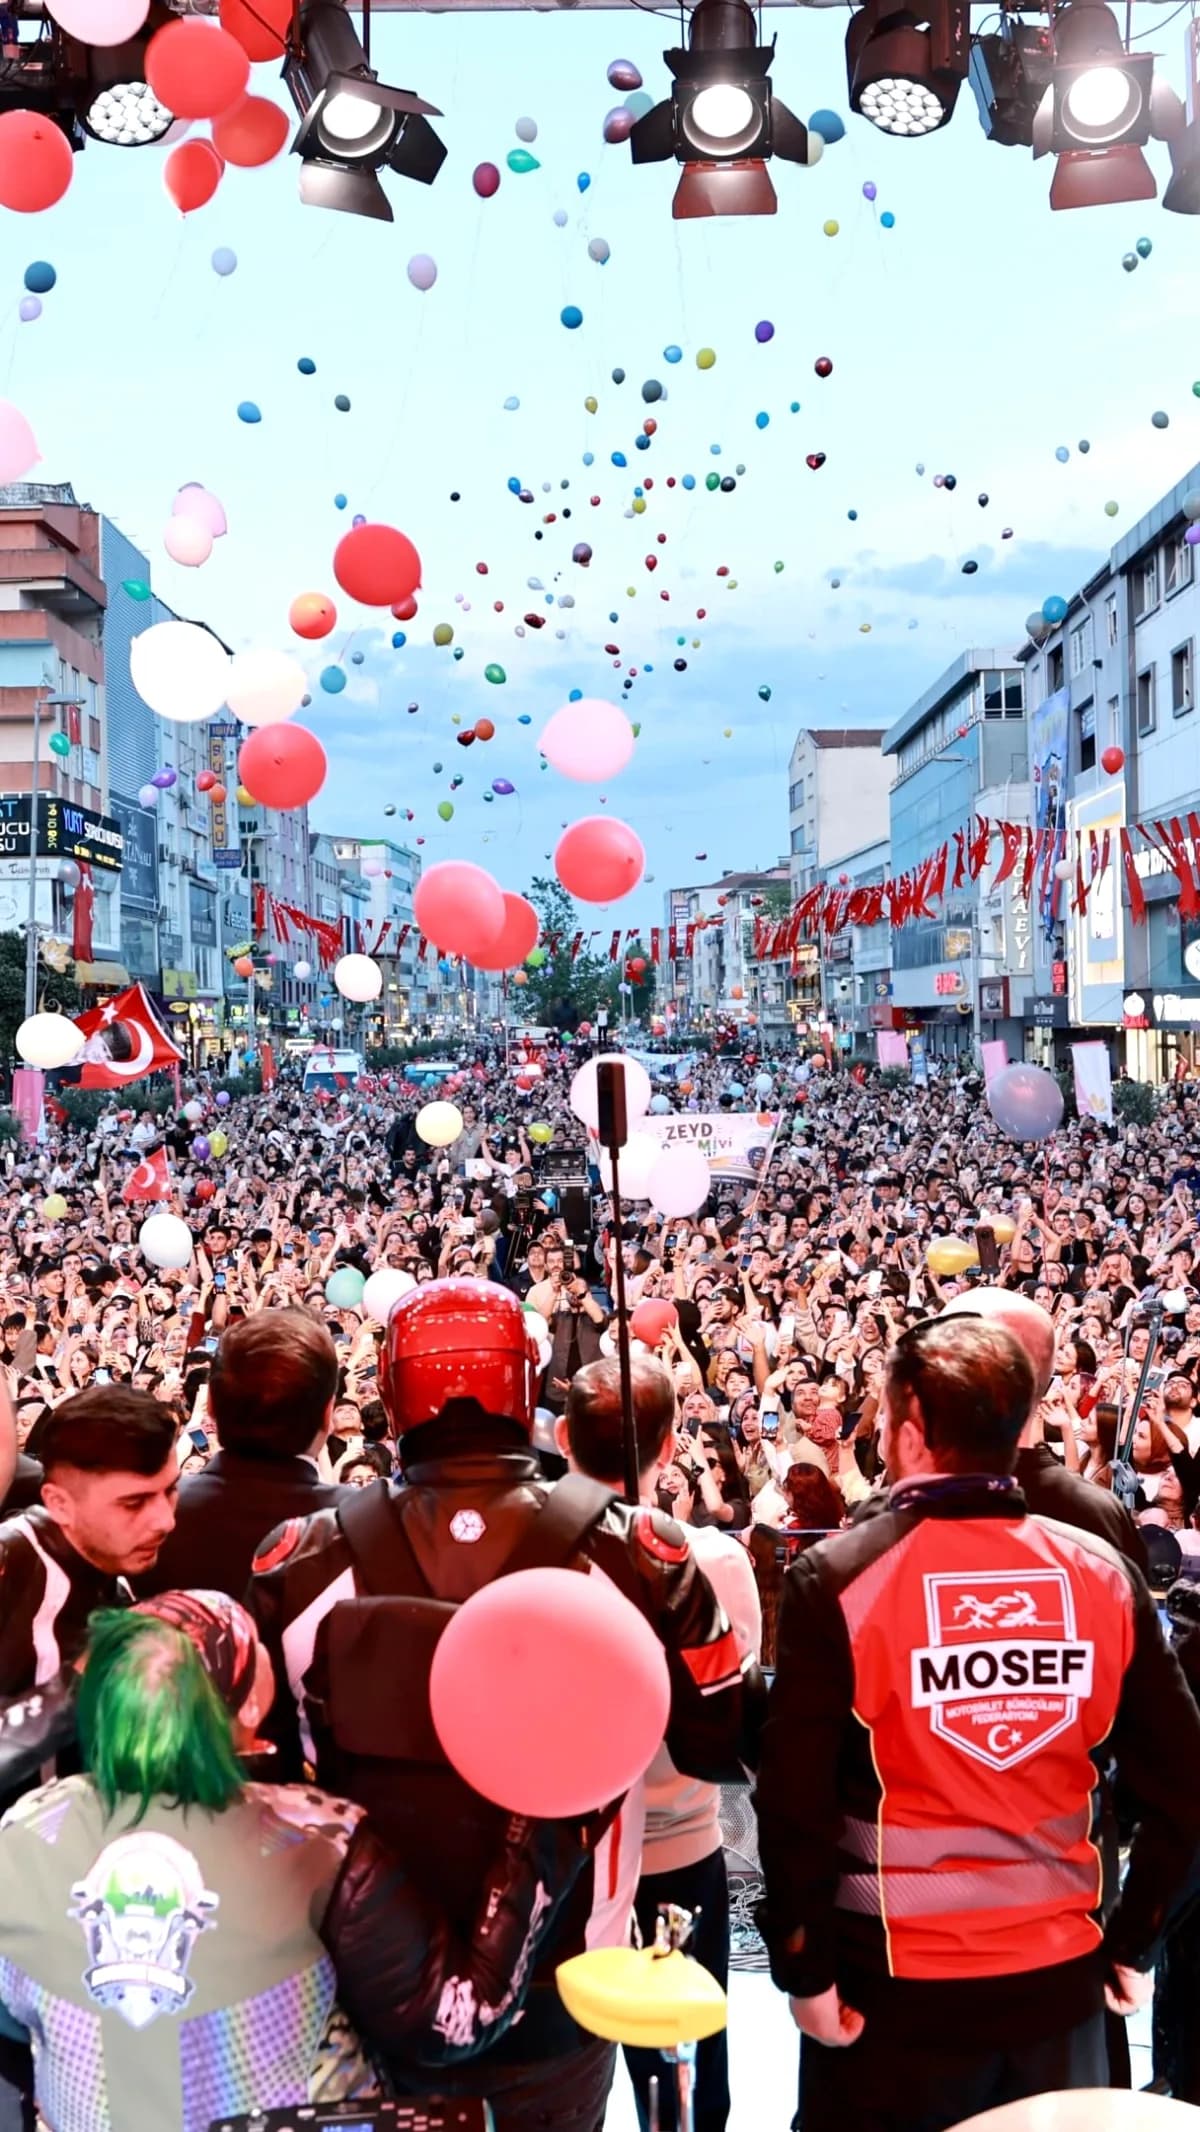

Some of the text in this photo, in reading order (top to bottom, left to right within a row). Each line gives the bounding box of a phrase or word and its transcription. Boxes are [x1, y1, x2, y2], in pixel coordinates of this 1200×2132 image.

[0, 801, 18, 817] T
[63, 807, 84, 835] YURT
[665, 1122, 713, 1140] ZEYD
[919, 1649, 1087, 1693] MOSEF
